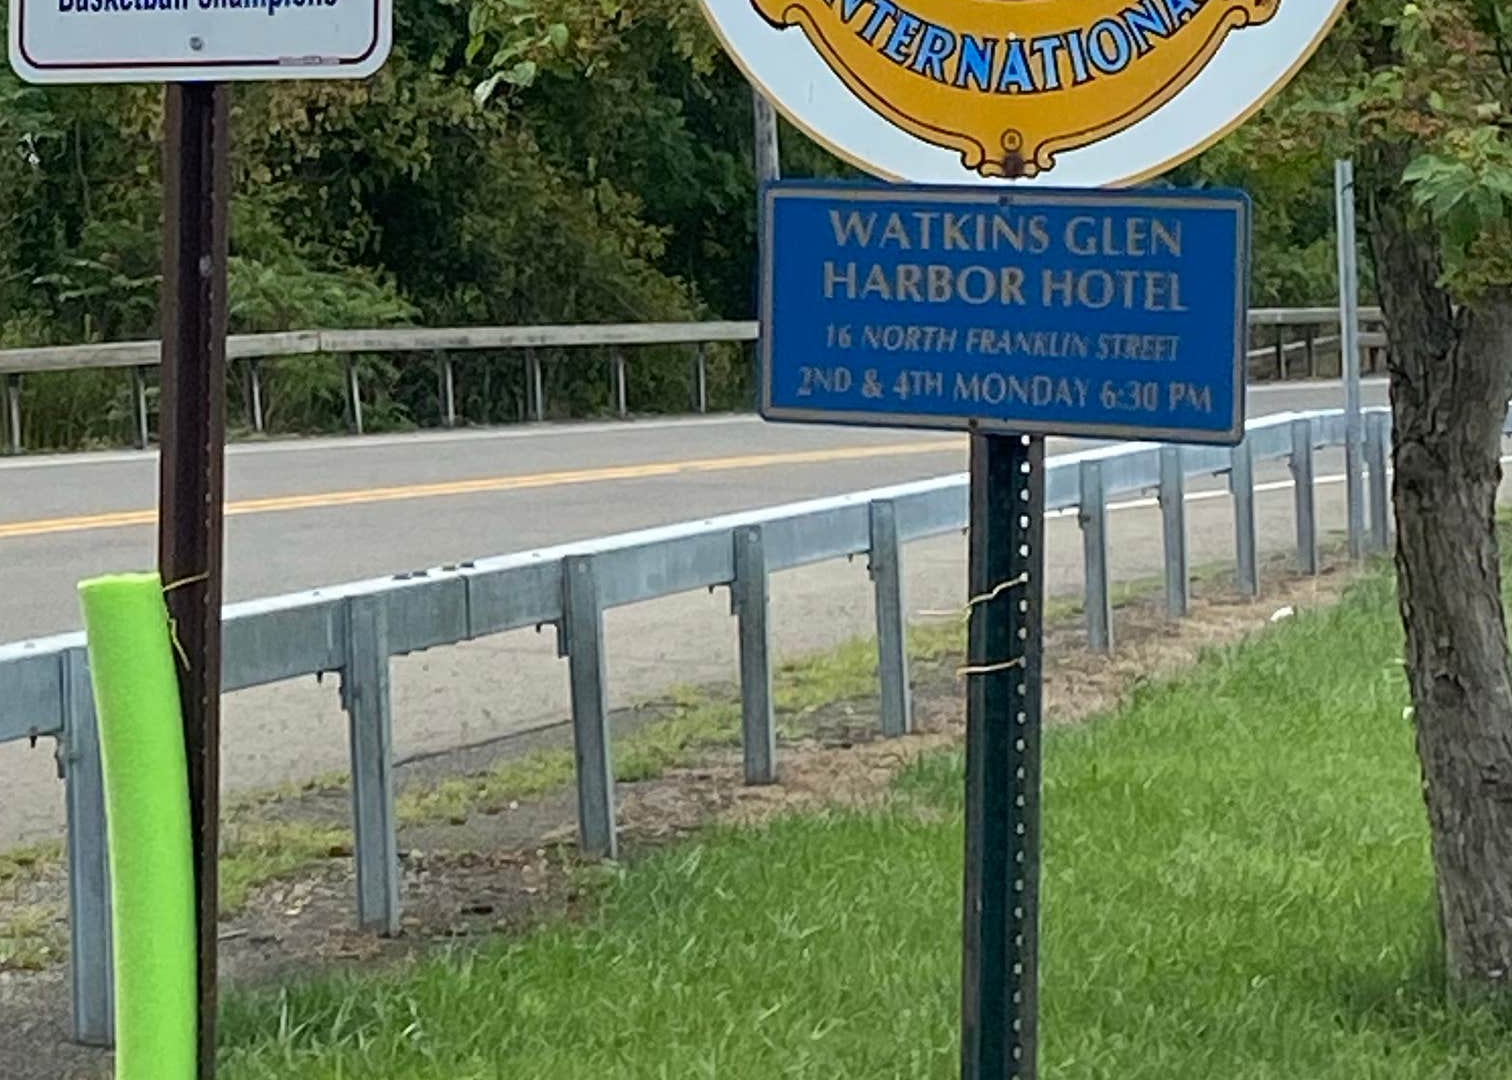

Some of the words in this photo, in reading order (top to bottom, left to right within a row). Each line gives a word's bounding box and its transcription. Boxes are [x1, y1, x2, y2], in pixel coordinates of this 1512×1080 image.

[829, 209, 1050, 253] WATKINS
[1064, 216, 1182, 257] GLEN
[823, 262, 1026, 306] HARBOR
[1041, 269, 1189, 312] HOTEL
[827, 324, 851, 349] 16
[861, 326, 957, 353] NORTH
[965, 328, 1088, 359] FRANKLIN
[1097, 333, 1179, 361] STREET
[797, 366, 852, 398] 2ND
[862, 368, 883, 399] &
[893, 369, 943, 401] 4TH
[953, 372, 1088, 408] MONDAY
[1100, 380, 1158, 411] 6:30
[1169, 382, 1212, 413] PM
